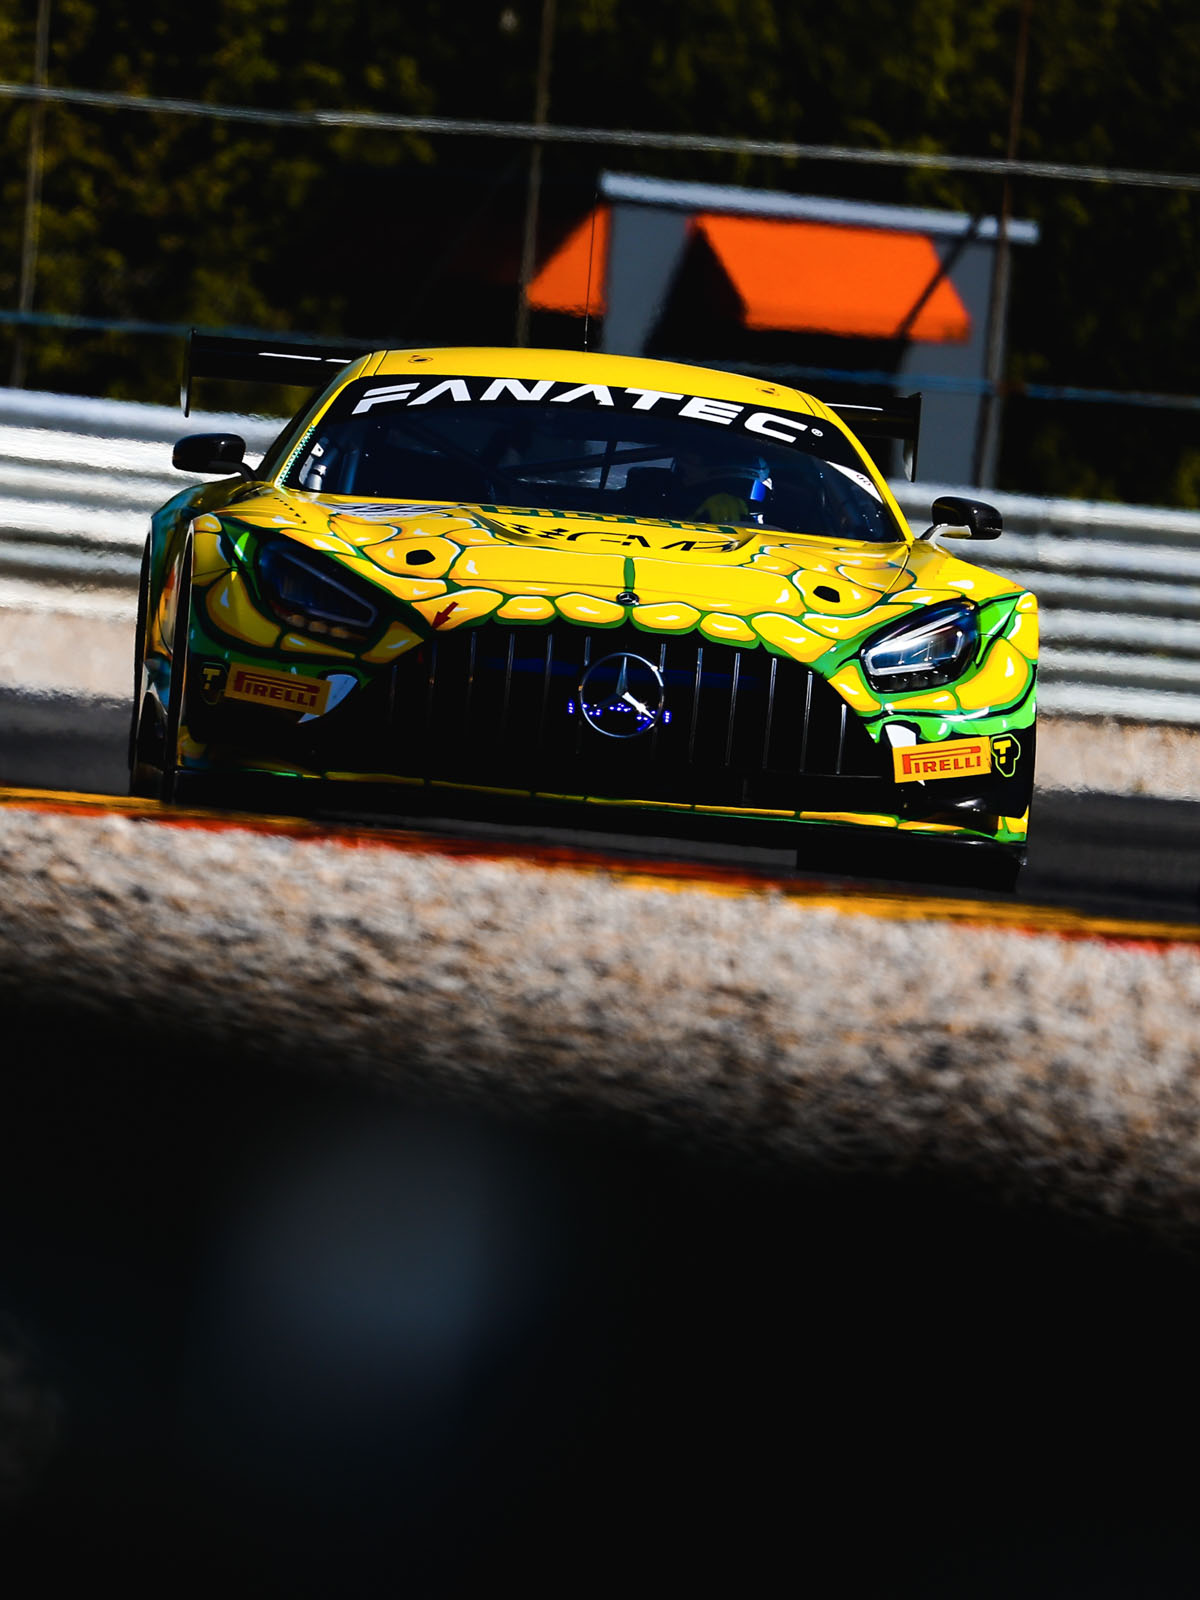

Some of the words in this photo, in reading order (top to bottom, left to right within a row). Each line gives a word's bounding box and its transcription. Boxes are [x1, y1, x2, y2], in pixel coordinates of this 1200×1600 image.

[352, 379, 807, 443] FANATEC
[234, 671, 320, 706] PIRELLI
[902, 746, 981, 774] PIRELLI
